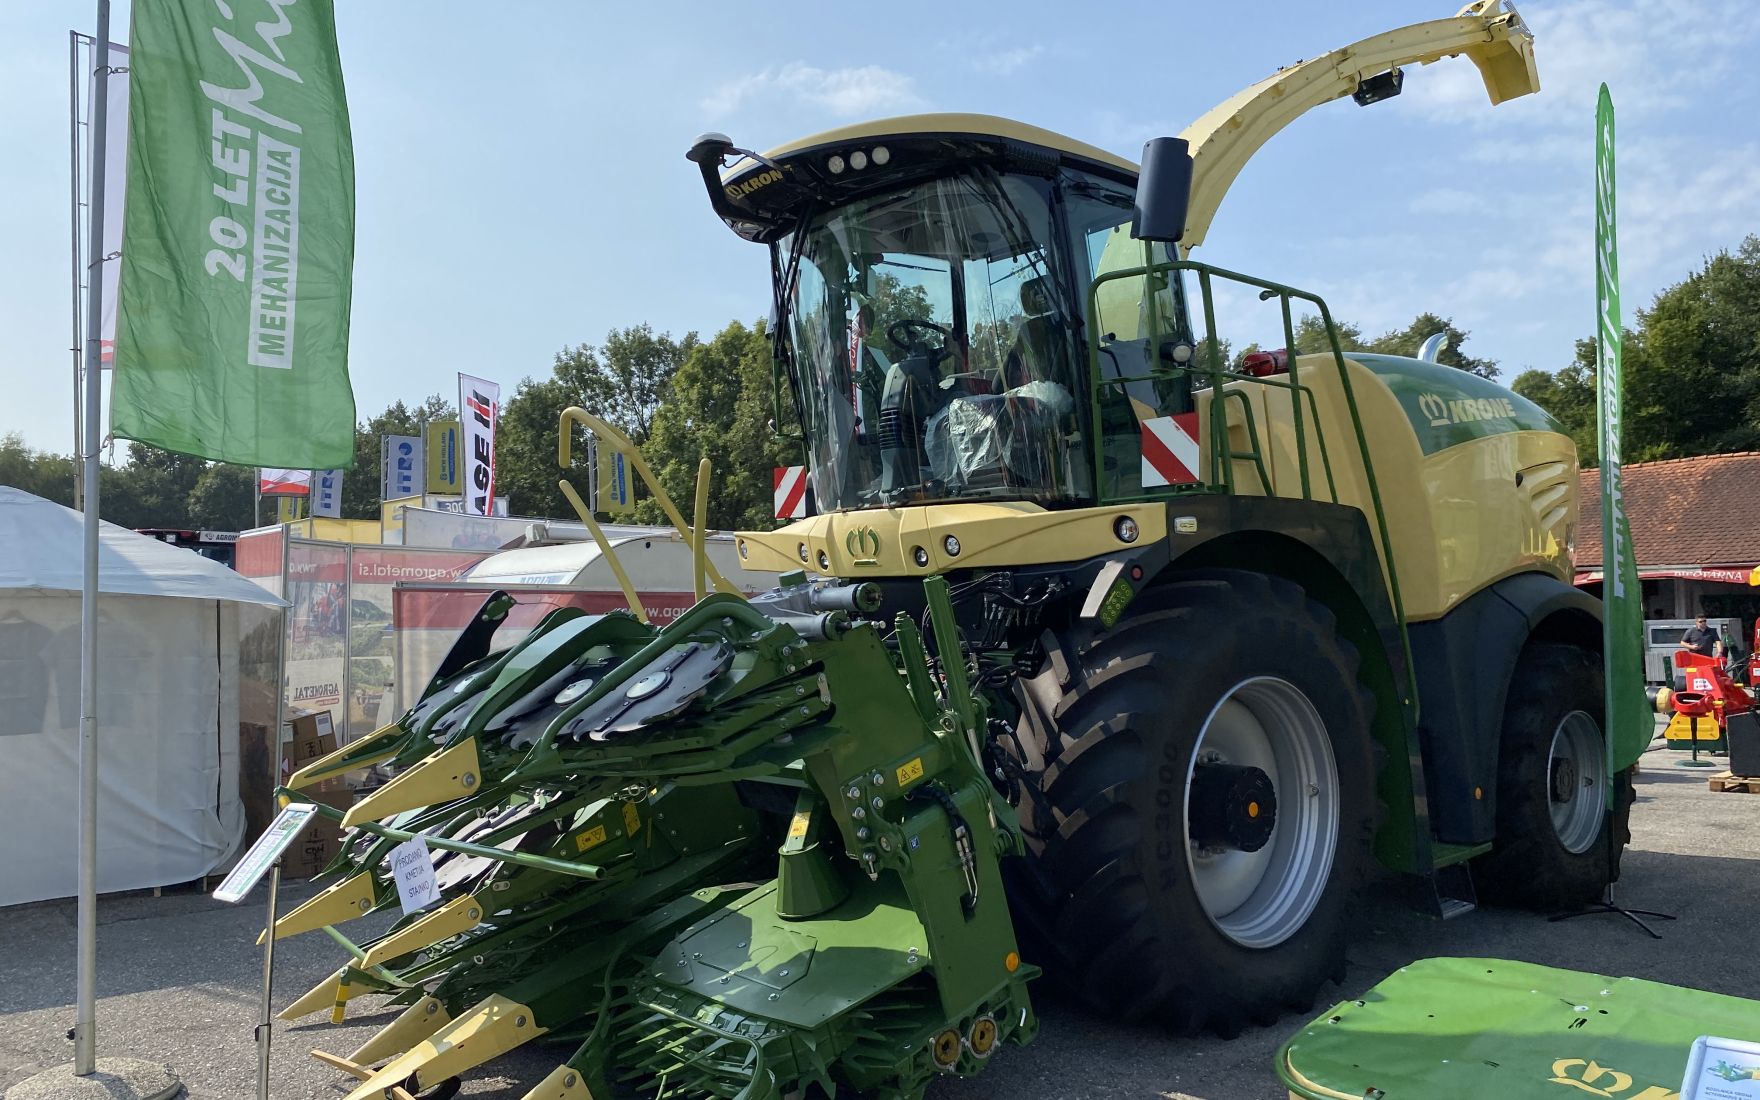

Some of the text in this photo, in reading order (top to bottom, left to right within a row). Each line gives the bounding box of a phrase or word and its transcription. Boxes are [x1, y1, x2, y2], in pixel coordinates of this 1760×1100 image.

[205, 110, 253, 283] 20 LET
[257, 149, 292, 357] MEHANIZACIJA
[1448, 398, 1517, 424] KRONE
